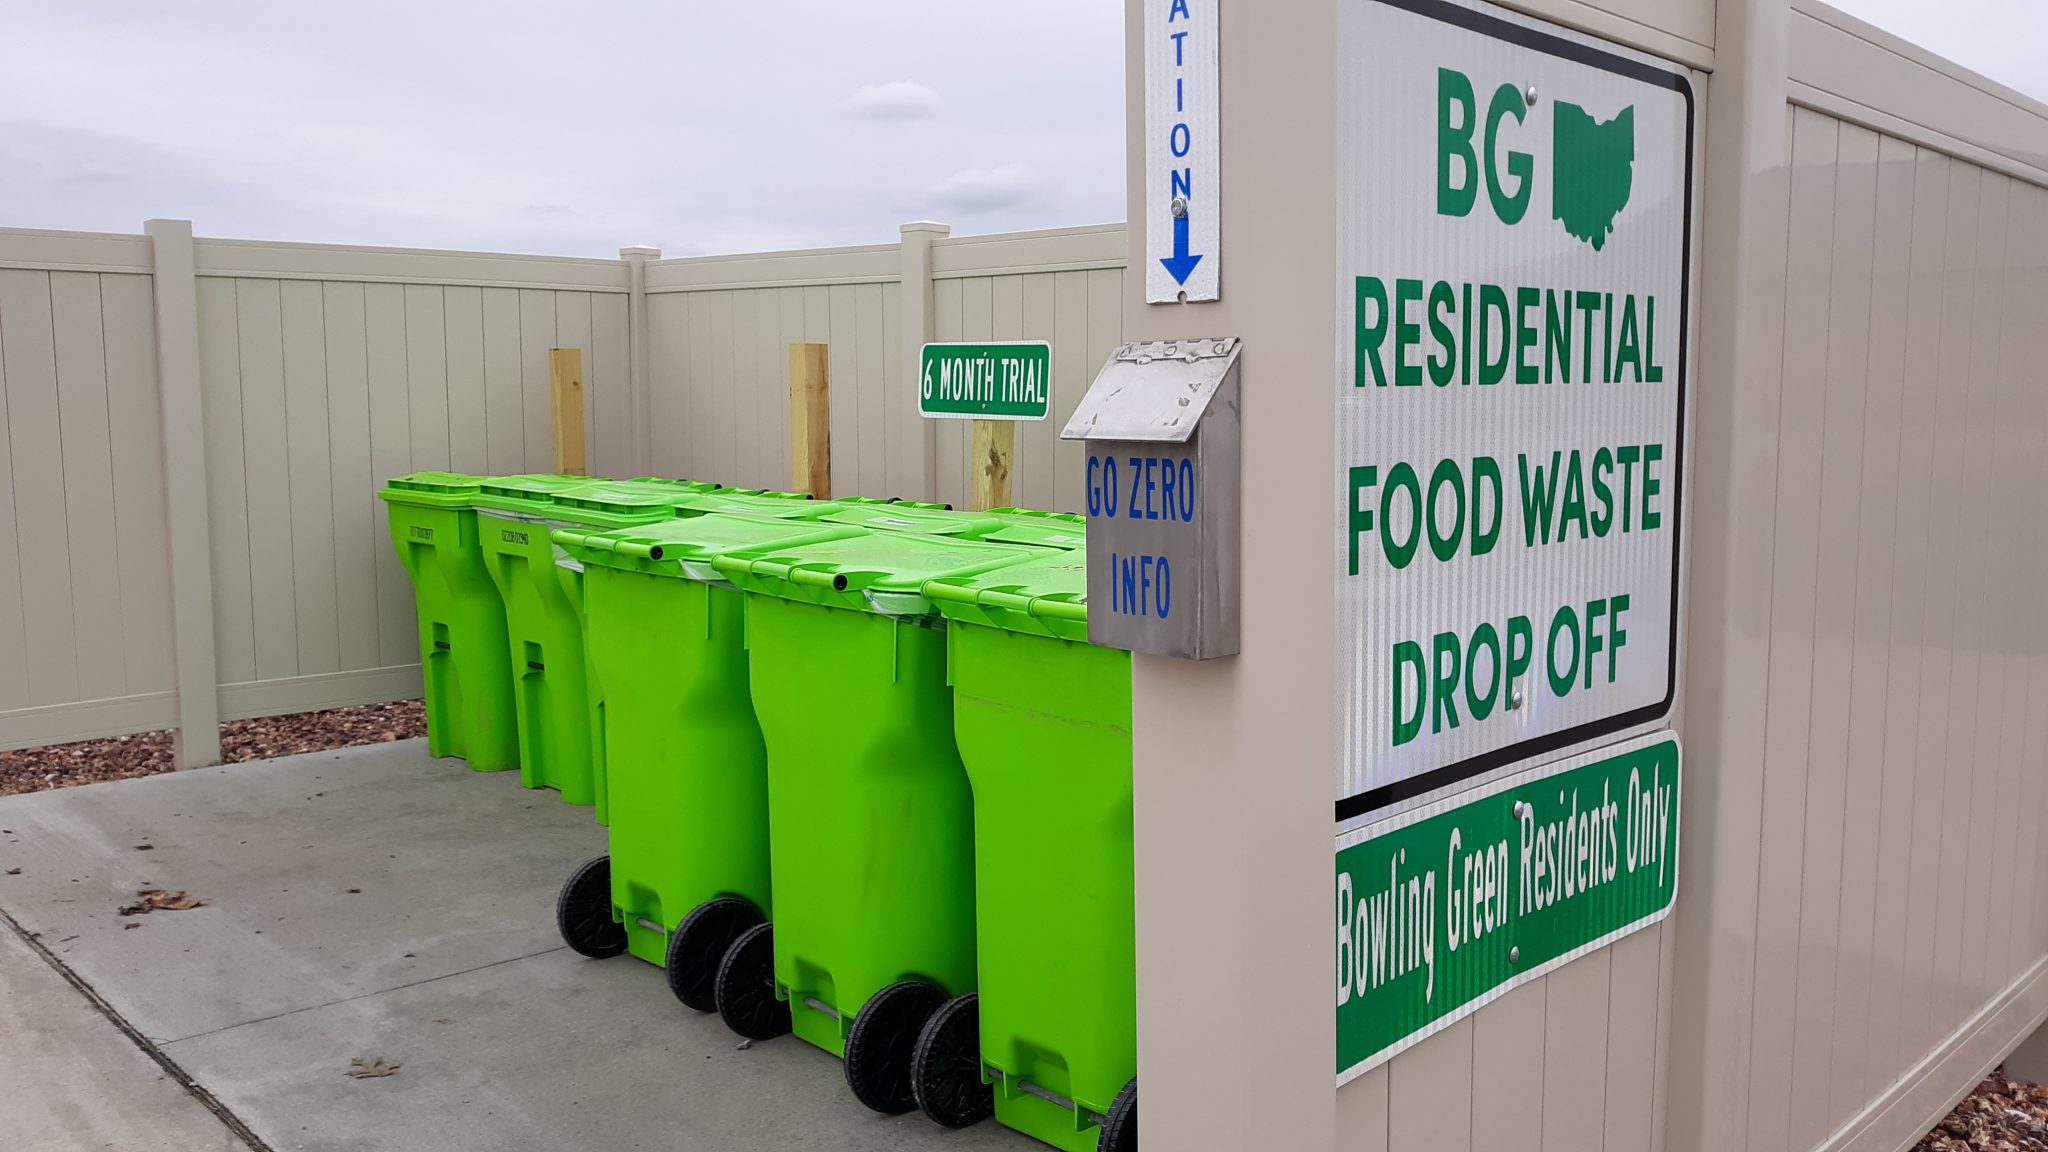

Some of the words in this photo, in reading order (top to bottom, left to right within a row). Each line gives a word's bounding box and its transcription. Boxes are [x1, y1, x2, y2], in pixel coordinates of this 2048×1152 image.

[1437, 67, 1534, 225] BG
[924, 358, 933, 400] 6
[940, 357, 995, 401] MONTH
[1001, 358, 1045, 403] TRIAL
[1355, 276, 1663, 387] RESIDENTIAL
[1087, 456, 1118, 518] GO
[1128, 457, 1194, 522] ZERO
[1349, 456, 1503, 576] FOOD
[1518, 444, 1663, 547] WASTE
[1112, 553, 1171, 619] INFO
[1392, 615, 1533, 747] DROP
[1546, 594, 1630, 697] OFF
[1337, 847, 1436, 1005] Bowling
[1447, 827, 1510, 952] Green
[1519, 776, 1618, 917] Residents
[1626, 761, 1671, 888] Only
